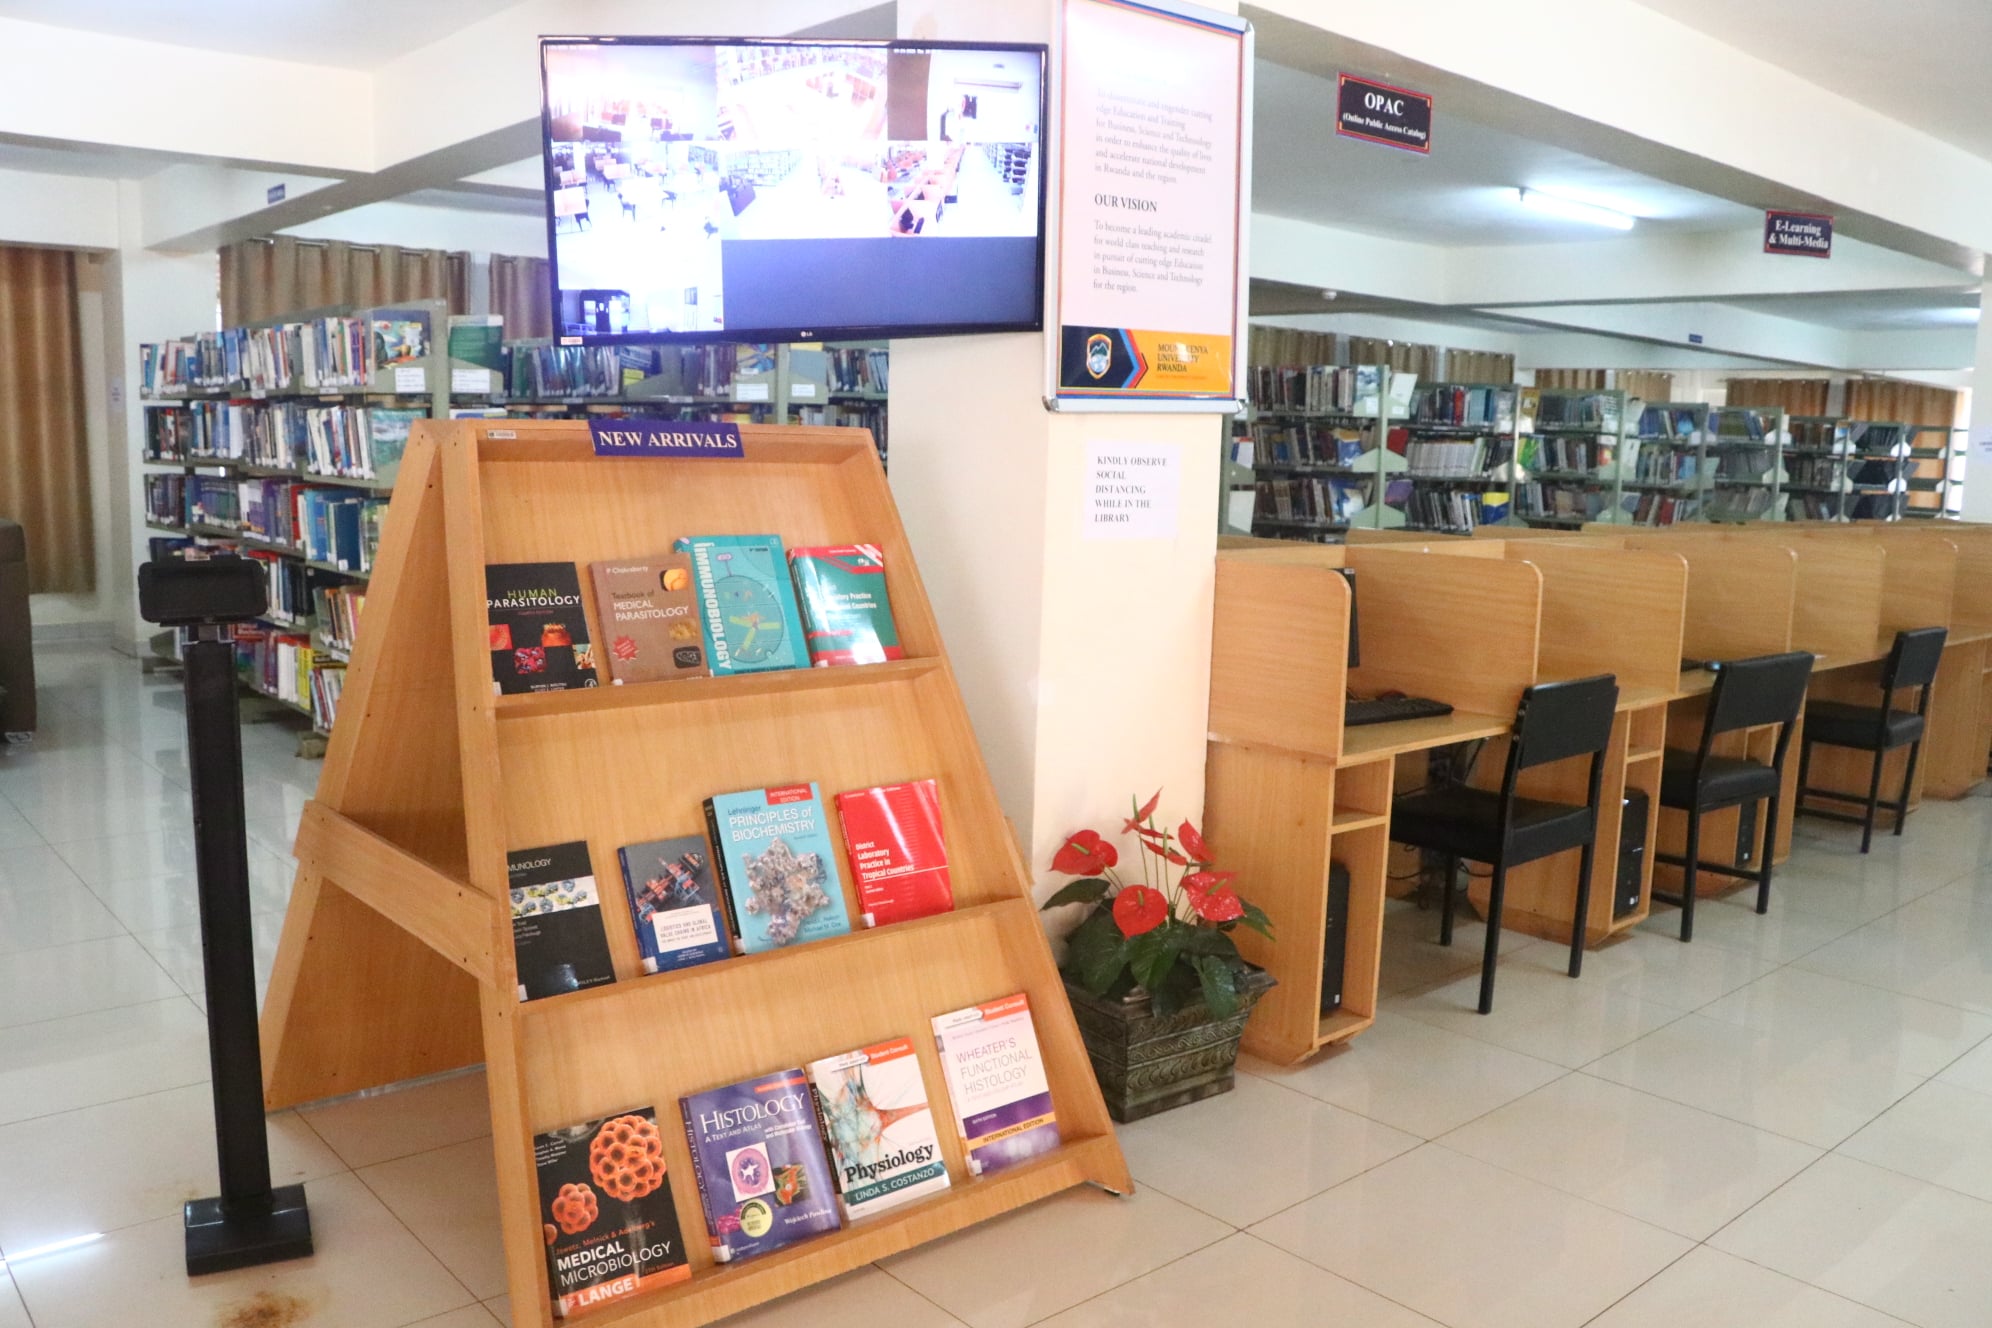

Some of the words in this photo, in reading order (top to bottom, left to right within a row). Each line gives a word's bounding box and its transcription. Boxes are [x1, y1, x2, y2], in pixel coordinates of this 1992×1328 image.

[1365, 92, 1404, 116] OPAC
[1148, 114, 1158, 123] and
[1343, 113, 1364, 124] (Online
[1365, 117, 1383, 128] Public
[1384, 123, 1402, 133] Access
[1105, 136, 1121, 144] order
[1160, 144, 1168, 153] the
[1171, 147, 1190, 158] quality
[1162, 131, 1174, 140] and
[1176, 132, 1211, 149] Technology
[1096, 148, 1107, 157] and
[1110, 152, 1140, 163] accelerate
[1142, 157, 1167, 167] national
[1169, 161, 1205, 174] development
[1104, 164, 1130, 176] Rwanda
[1132, 169, 1144, 178] and
[1146, 171, 1155, 180] the
[1095, 193, 1118, 207] OUR
[1121, 196, 1157, 212] VISION
[1094, 220, 1103, 230] To
[1105, 221, 1130, 233] become
[1139, 225, 1161, 240] leading
[1776, 220, 1821, 237] E-Learning
[1094, 235, 1102, 244] for
[1105, 238, 1123, 247] world
[1125, 240, 1139, 249] class
[1142, 242, 1167, 254] teaching
[1182, 247, 1204, 256] research
[1769, 233, 1776, 243] &
[1779, 234, 1828, 248] Multi-Media
[1102, 253, 1124, 262] pursuit
[1127, 253, 1134, 262] of
[1135, 256, 1157, 267] cutting
[1159, 259, 1172, 268] edge
[1174, 258, 1203, 270] Education
[1093, 279, 1102, 288] for
[1105, 281, 1115, 289] the
[1133, 269, 1154, 279] Science
[1157, 272, 1168, 280] and
[1171, 272, 1202, 286] Technology
[1158, 344, 1181, 352] MOUN
[1158, 353, 1200, 363] UNIVETY
[1157, 363, 1187, 372] RWANDA
[598, 432, 642, 446] NEW
[648, 433, 737, 448] ARRIVALS
[1098, 456, 1128, 464] KINDLY
[1131, 457, 1167, 466] OBSERVE
[1097, 471, 1125, 479] SOCIAL
[1096, 485, 1146, 494] DISTANCING
[1096, 499, 1121, 508] WHILE
[1125, 500, 1133, 508] IN
[1136, 500, 1151, 508] THE
[1095, 514, 1130, 522] LIBRARY
[487, 596, 580, 608] PARASITOLOGY
[507, 588, 557, 599] HUMAN
[613, 600, 654, 610] MEDICAL
[616, 606, 689, 621] PARASITOLOGY
[693, 542, 732, 669] IMMUNOBIOLOGY
[770, 788, 808, 797] INTERNATIONAL
[729, 809, 798, 827] PRINCIPLES
[802, 808, 812, 817] of
[733, 820, 816, 842] BIOCHEMISTRY
[856, 841, 874, 850] District
[857, 849, 890, 860] Laboratory
[860, 860, 883, 870] Practice
[862, 869, 886, 880] Tropical
[887, 864, 915, 875] Countries
[957, 1037, 1017, 1063] WHEATER'S
[961, 1050, 1032, 1080] FUNCTIONAL
[965, 1065, 1028, 1095] HISTOLOGY
[700, 1093, 805, 1134] HISTOLOGY
[712, 1131, 728, 1141] TEXT
[729, 1128, 741, 1137] AND
[742, 1123, 762, 1132] ATLAS
[983, 1127, 1022, 1143] INTERNATIONAL
[1023, 1119, 1044, 1128] EDITION
[845, 1145, 934, 1183] Physiology
[855, 1187, 881, 1201] LINDA
[882, 1183, 890, 1192] S.
[891, 1168, 935, 1188] COSTANZO
[557, 1240, 625, 1271] MEDICAL
[560, 1241, 672, 1287] MICROBIOLOGY
[578, 1278, 633, 1307] LANGE
